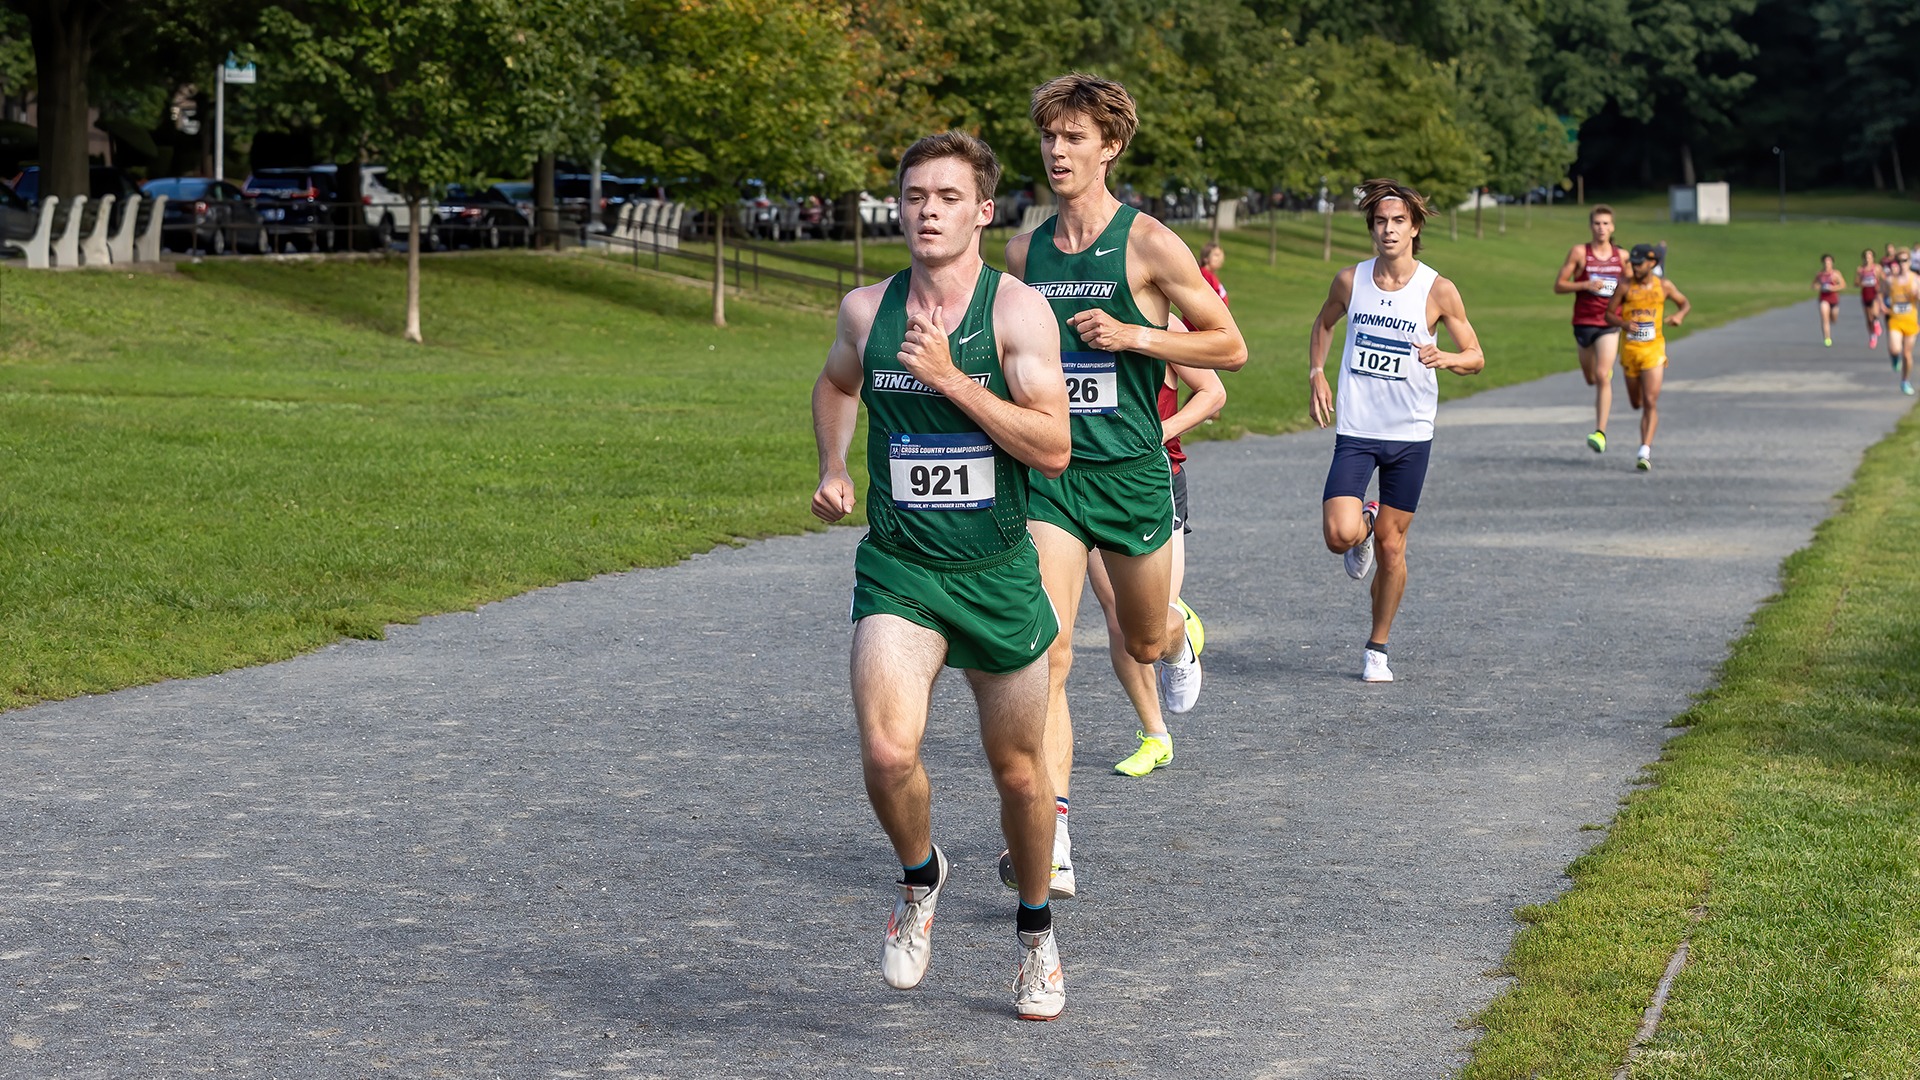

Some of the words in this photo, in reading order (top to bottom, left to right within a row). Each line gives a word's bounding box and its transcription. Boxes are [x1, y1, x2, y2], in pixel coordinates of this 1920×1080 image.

[1036, 284, 1113, 297] NGHAMTON
[1353, 313, 1417, 333] MONMOUTH
[1359, 351, 1401, 373] 1021
[1065, 378, 1099, 403] 26
[946, 444, 993, 454] CHAMPIONSHIPS
[910, 465, 970, 496] 921
